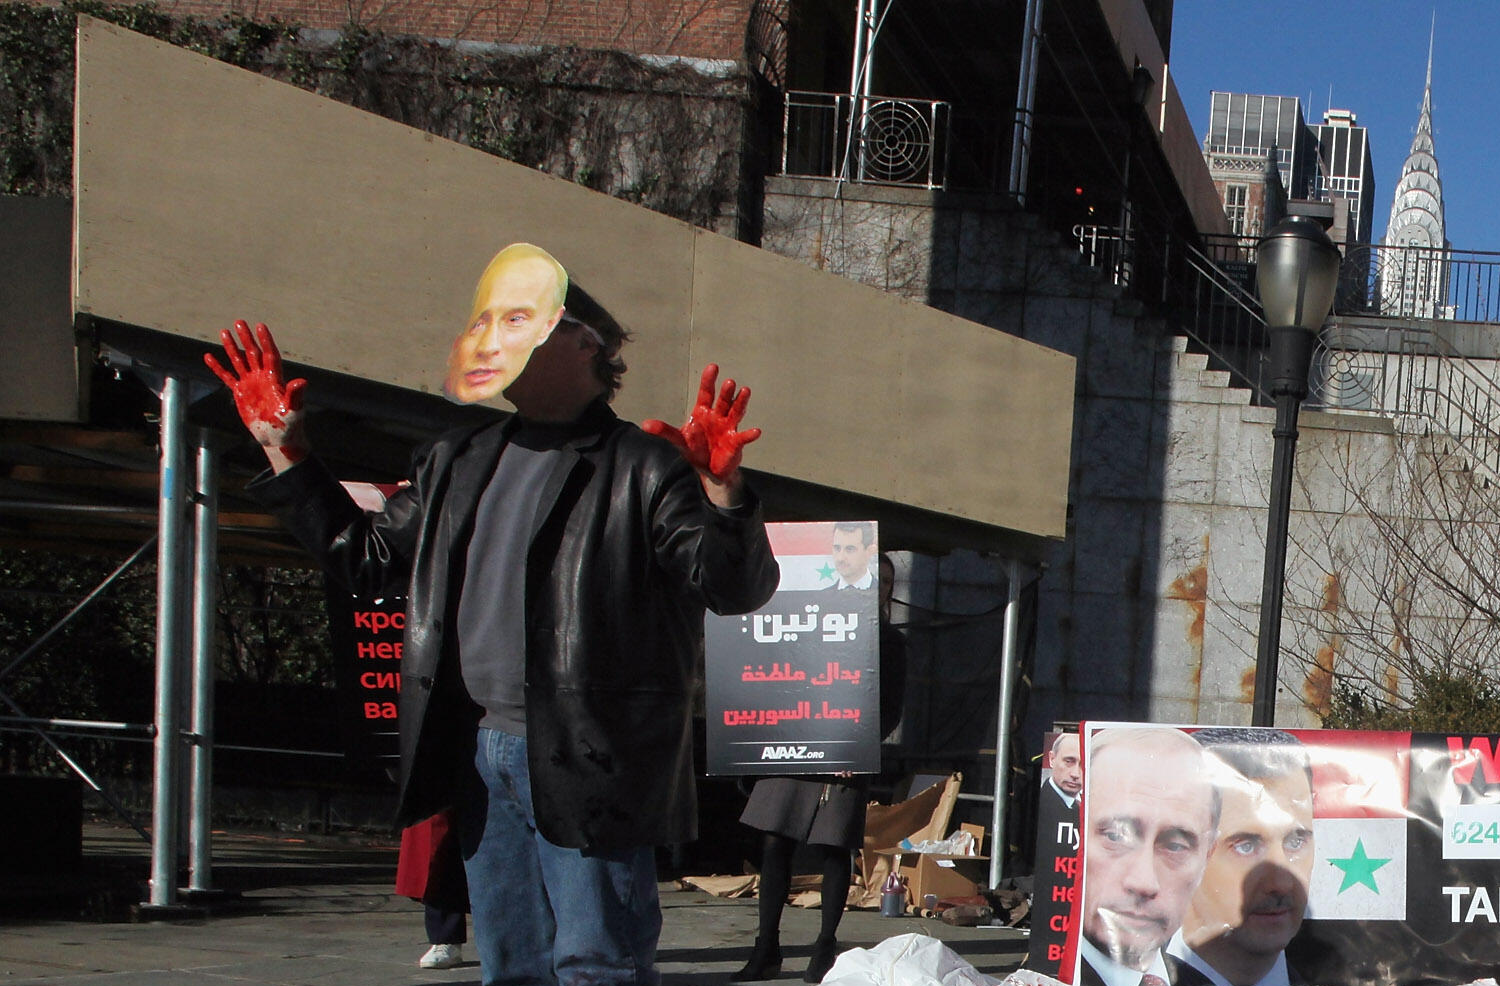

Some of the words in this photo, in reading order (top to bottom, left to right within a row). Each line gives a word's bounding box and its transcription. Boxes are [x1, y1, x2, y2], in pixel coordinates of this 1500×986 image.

[354, 611, 406, 634] кро
[742, 604, 859, 643] بوتين:
[357, 641, 404, 659] нев
[741, 662, 806, 682] ملطخة
[810, 662, 861, 686] يداك
[364, 701, 397, 719] ва
[723, 701, 811, 726] السوريين
[815, 701, 861, 724] بدماء
[1057, 821, 1081, 850] Пу
[1054, 856, 1078, 879] кр
